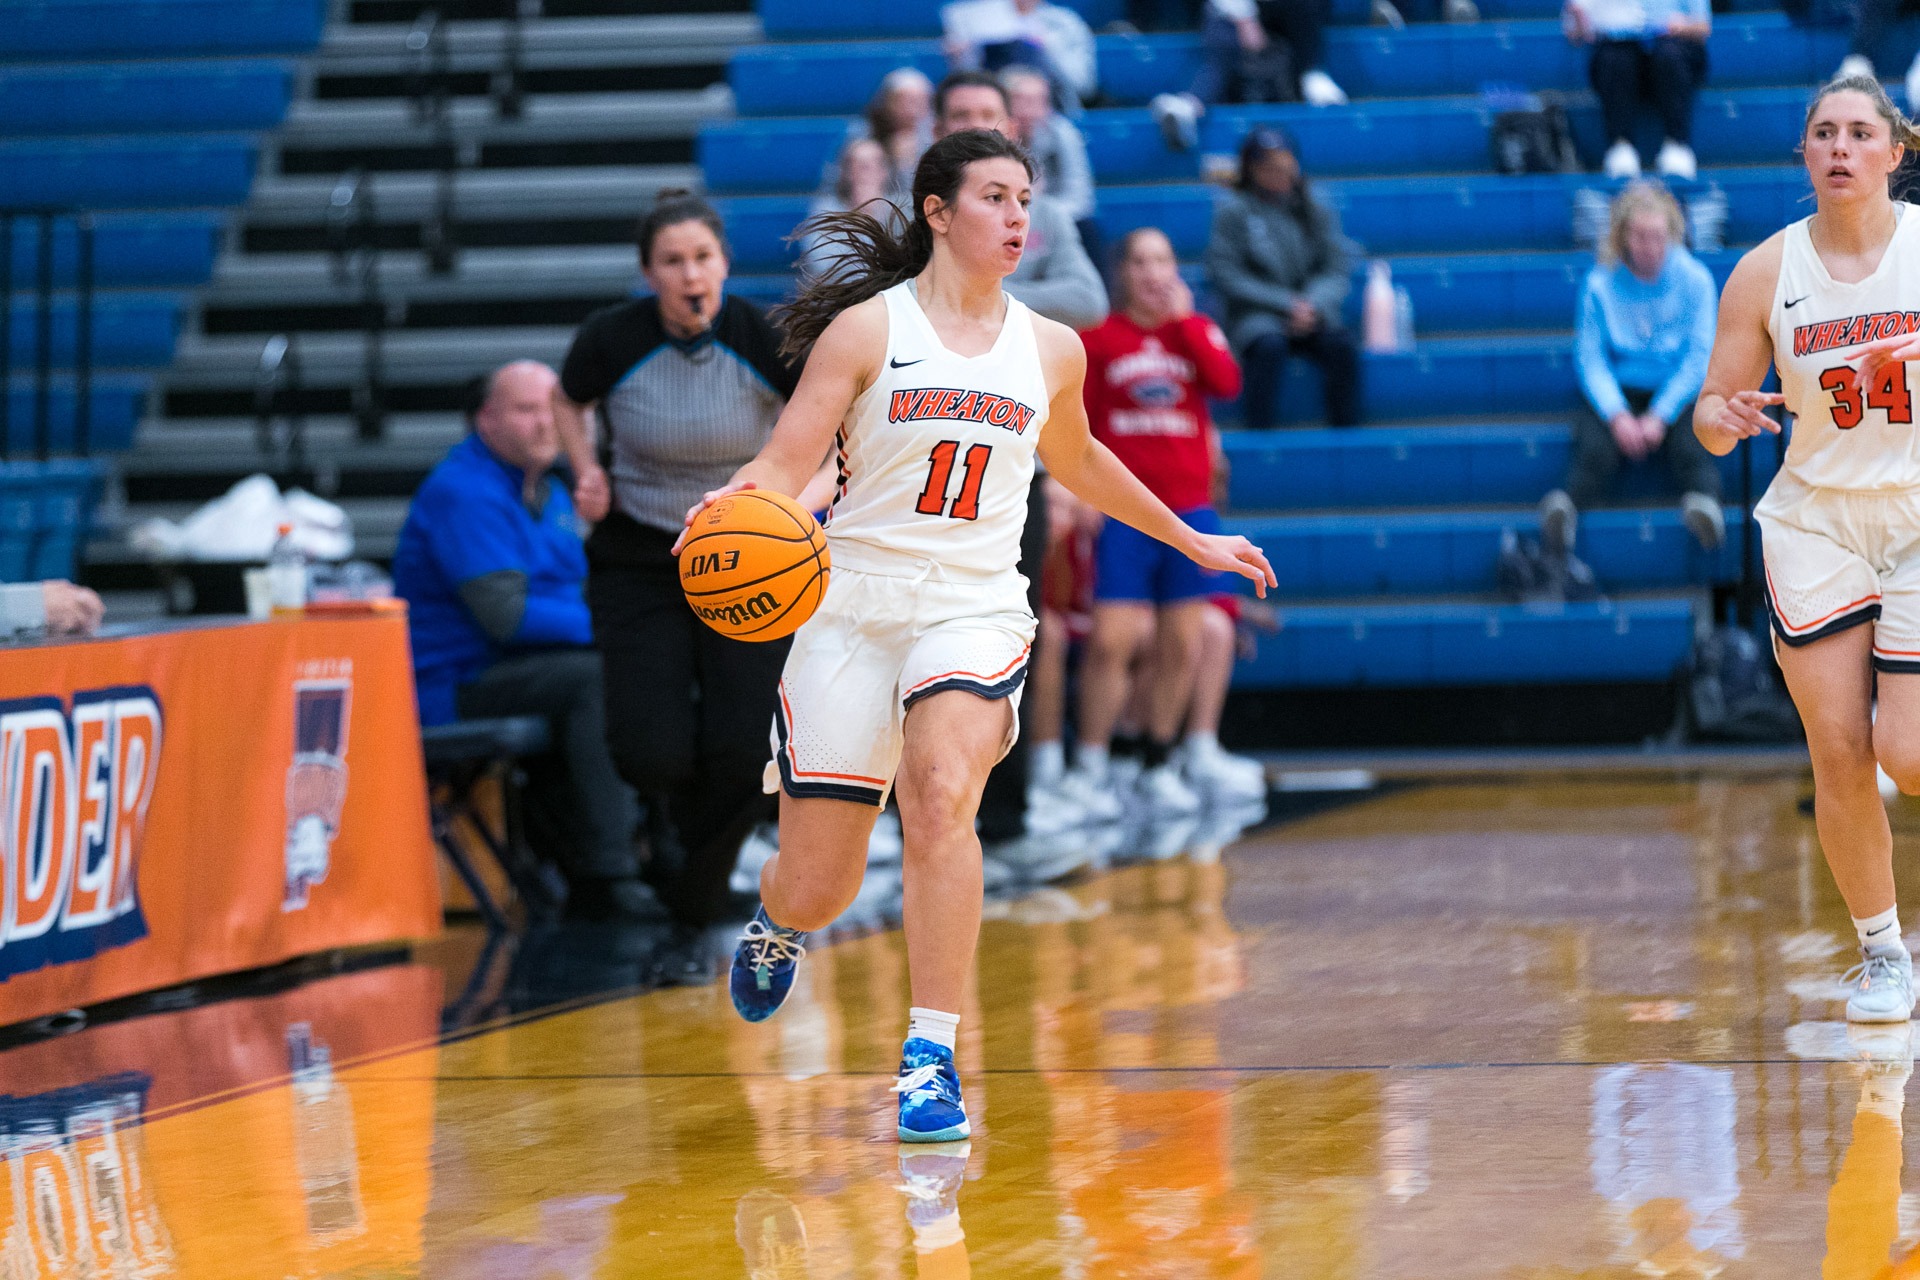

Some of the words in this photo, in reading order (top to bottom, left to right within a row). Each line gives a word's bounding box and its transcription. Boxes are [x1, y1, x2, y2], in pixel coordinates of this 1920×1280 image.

[1793, 311, 1920, 357] WHEATON
[889, 387, 1036, 436] WHEATON
[1819, 361, 1912, 430] 34
[915, 440, 993, 520] 11
[691, 550, 740, 578] EVO
[691, 591, 782, 626] Wilson
[0, 698, 164, 948] DER
